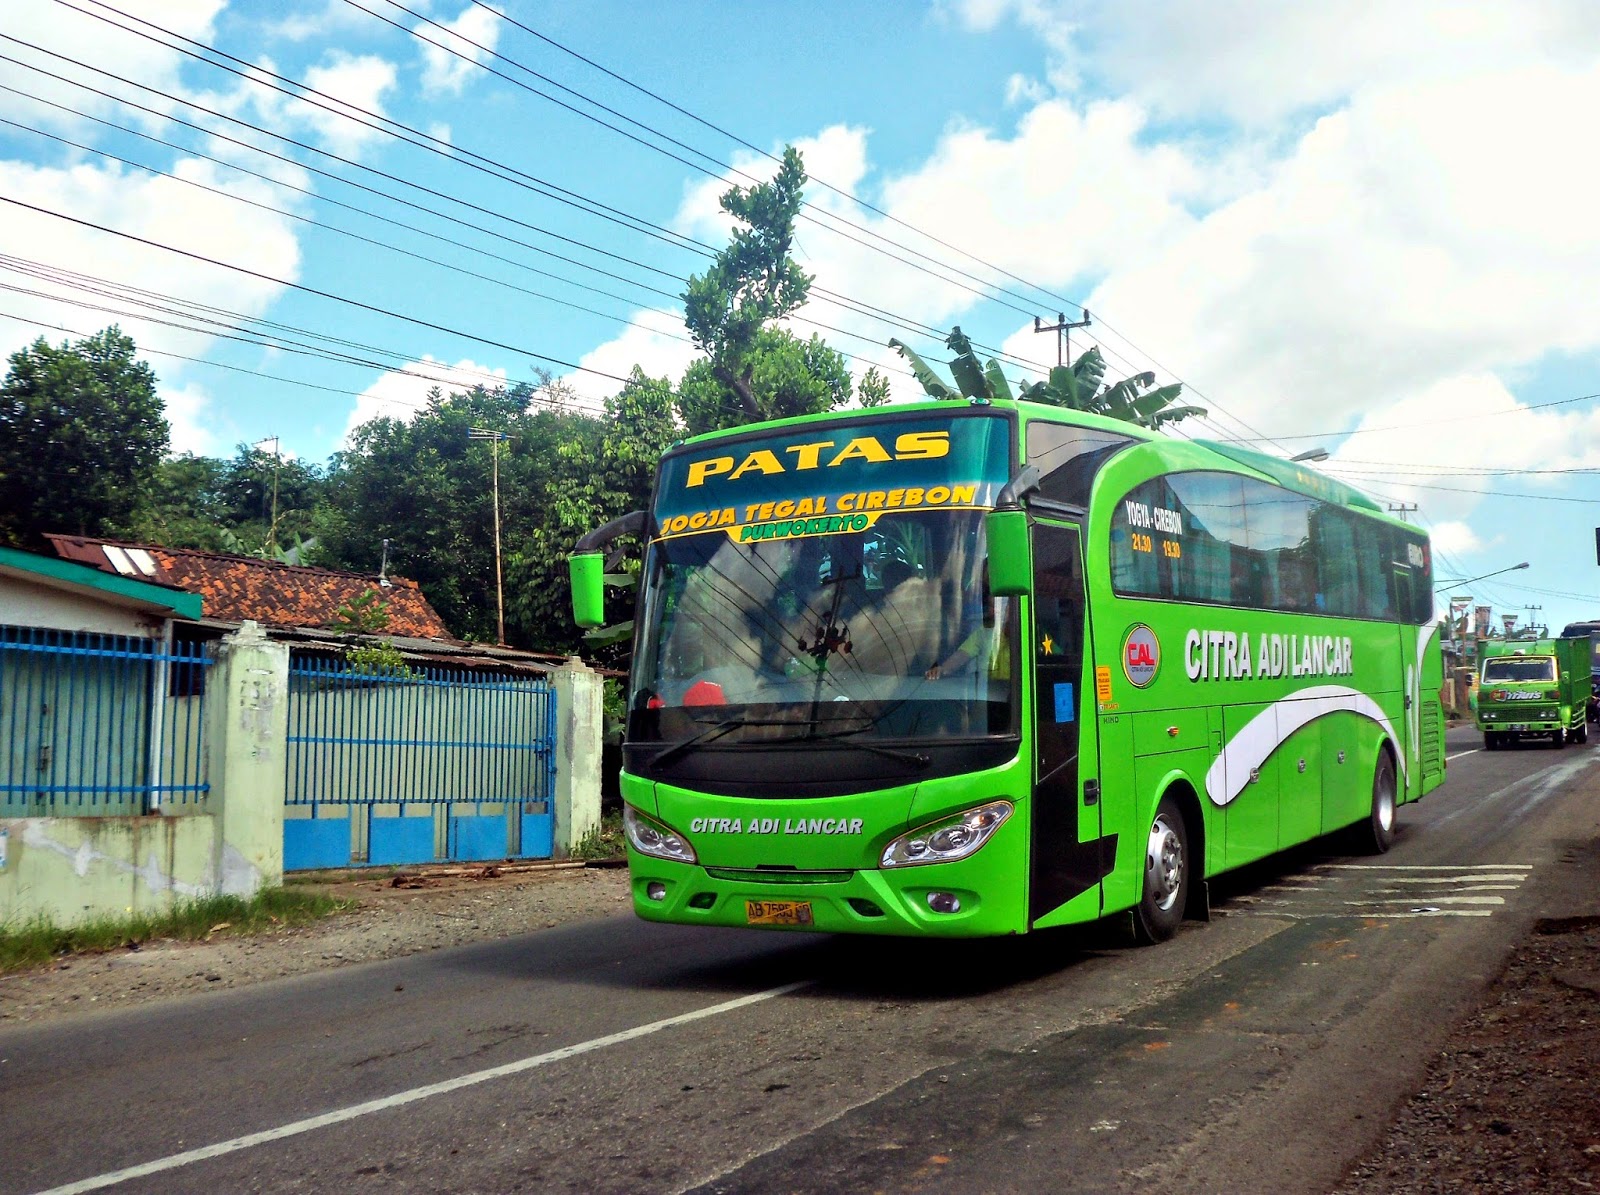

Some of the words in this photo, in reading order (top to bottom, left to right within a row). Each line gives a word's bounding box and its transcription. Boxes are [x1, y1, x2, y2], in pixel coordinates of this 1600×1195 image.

[685, 431, 950, 488] PATAS
[660, 507, 736, 535] JOGJA
[745, 496, 827, 522] TEGAL
[836, 485, 975, 511] CIREBON
[1126, 500, 1151, 529] YOGYA
[1153, 506, 1183, 535] CIREBON
[739, 513, 869, 542] PURWOKERTO
[1131, 533, 1152, 553] 21.30
[1163, 540, 1181, 558] 19.30
[1128, 643, 1155, 666] CAL
[1185, 628, 1253, 682] CITRA
[1257, 632, 1289, 680] ADI
[1291, 634, 1353, 679] LANCAR
[690, 818, 743, 834] CITRA
[748, 818, 780, 835] ADI
[784, 818, 864, 835] LANCAR
